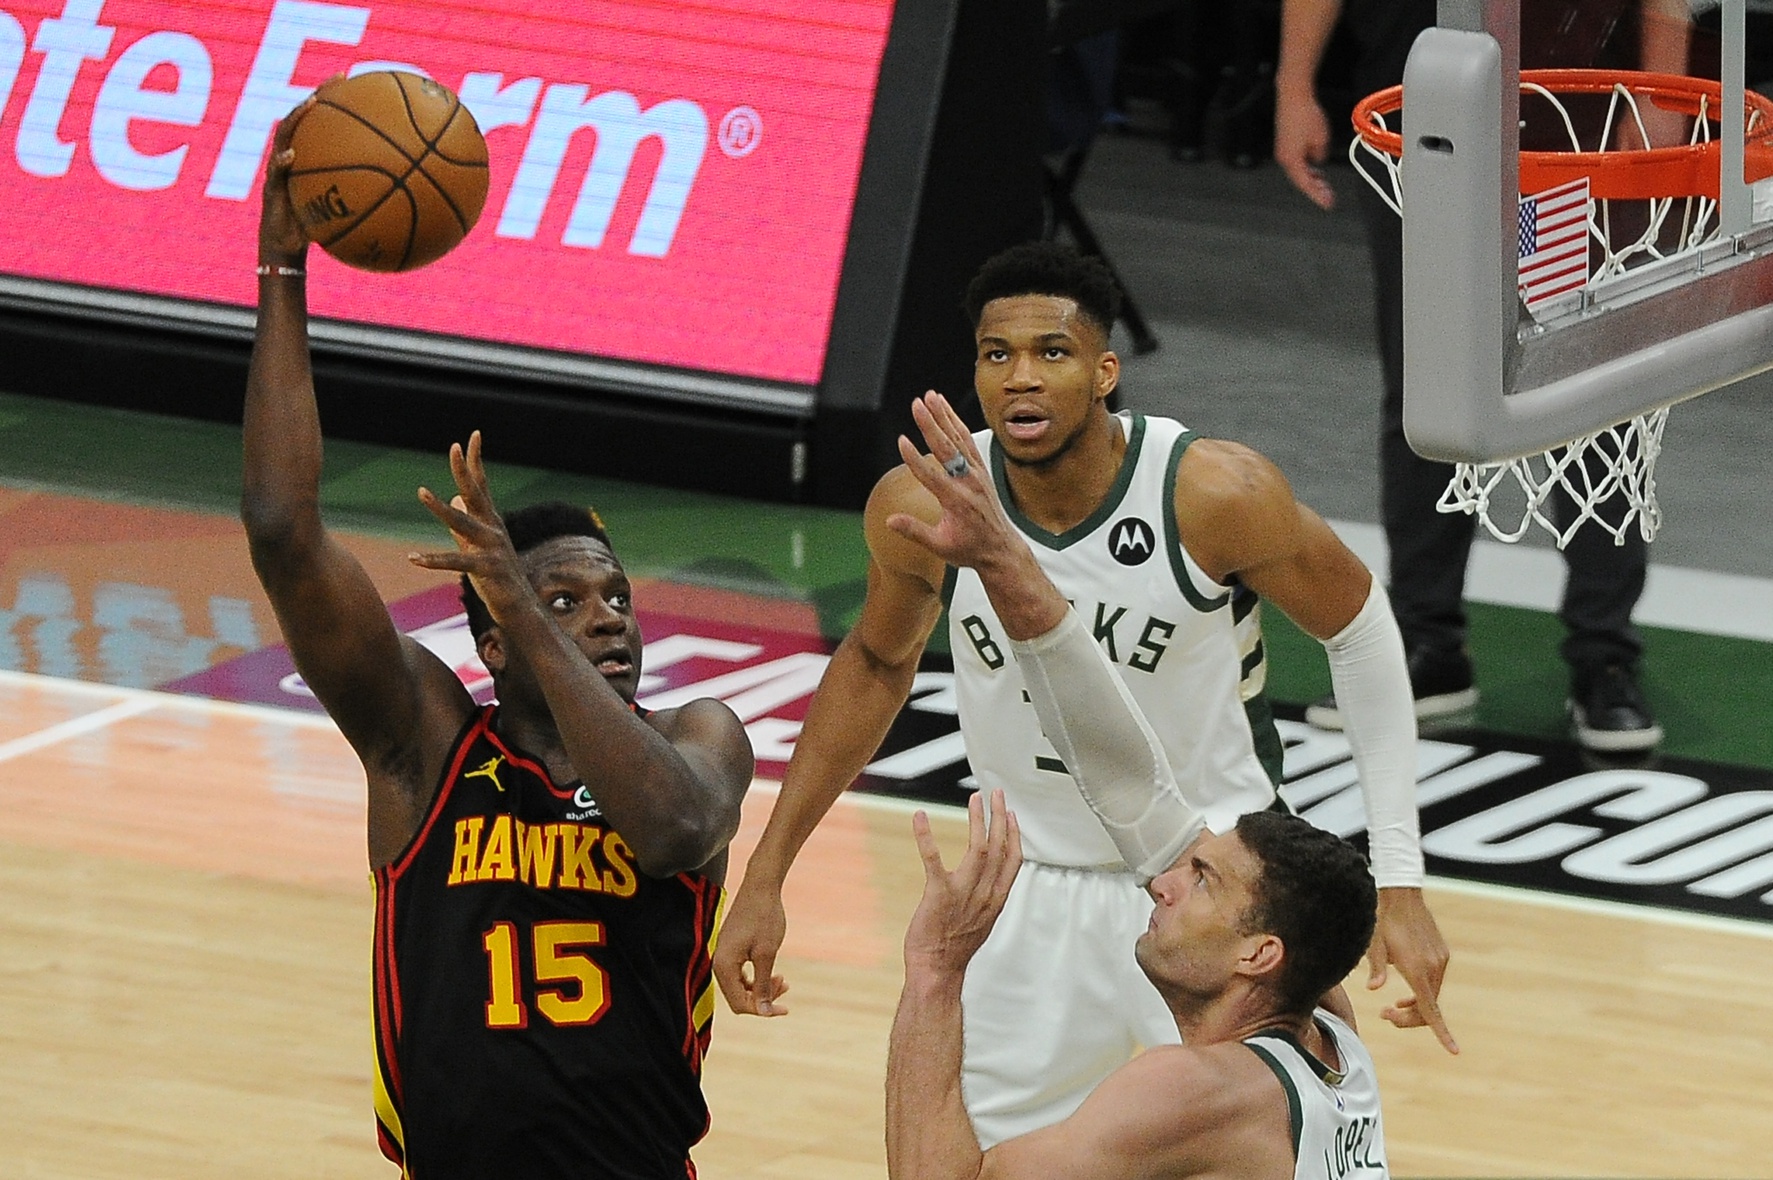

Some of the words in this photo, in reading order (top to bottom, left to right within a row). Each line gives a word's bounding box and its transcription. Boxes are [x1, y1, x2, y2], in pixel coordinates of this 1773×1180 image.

[960, 600, 1177, 674] BKS
[447, 813, 638, 898] HAWKS
[482, 920, 611, 1029] 15
